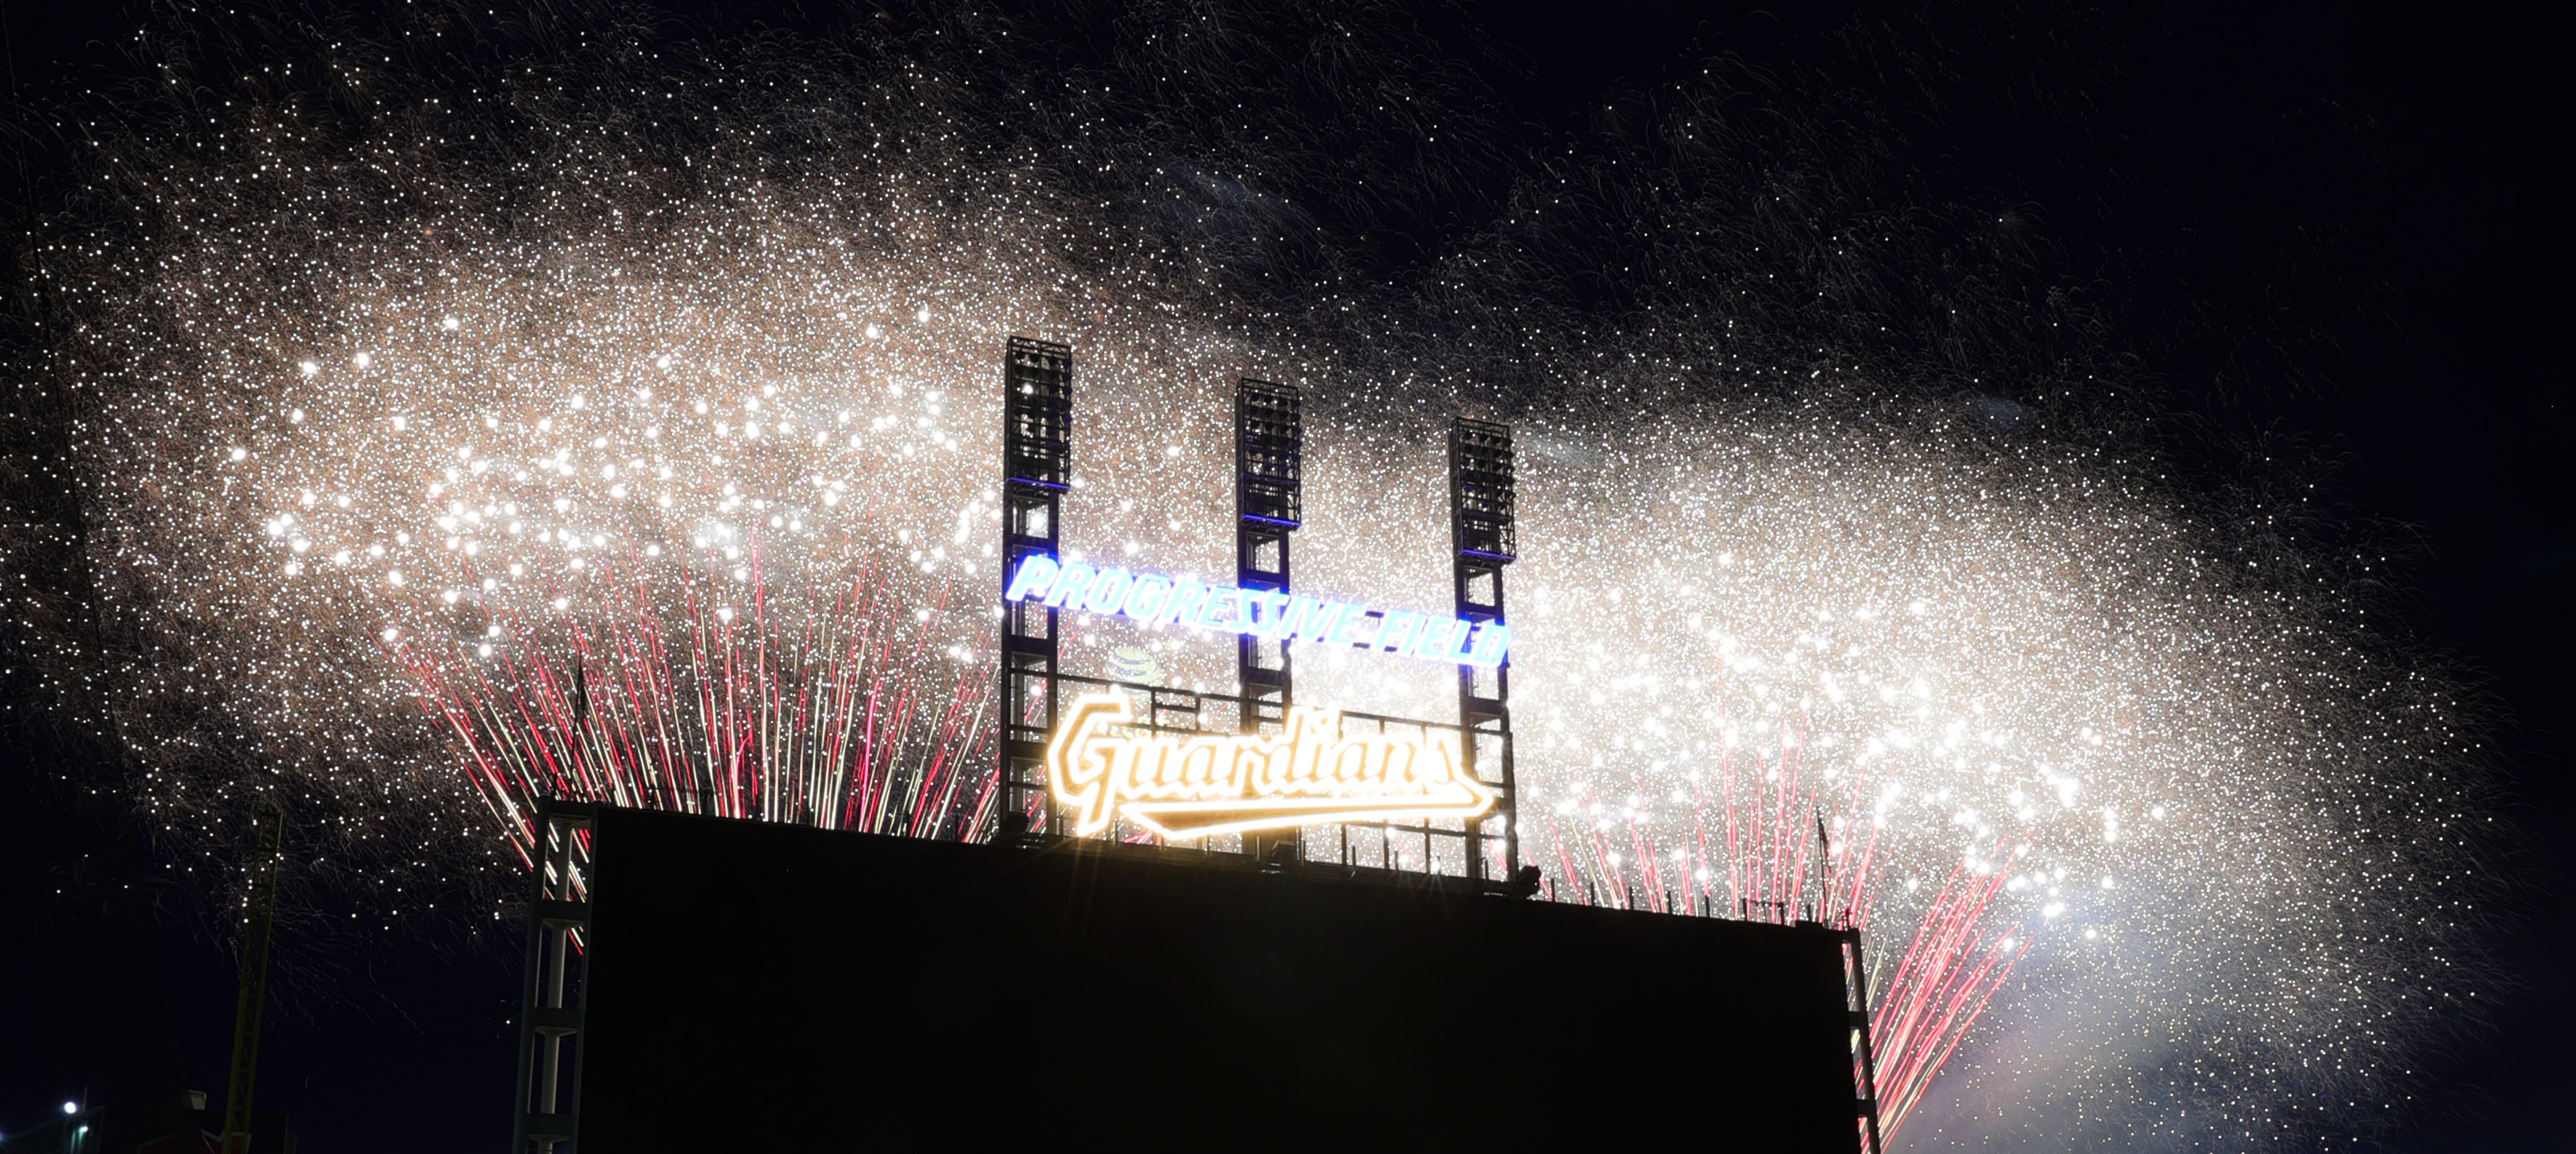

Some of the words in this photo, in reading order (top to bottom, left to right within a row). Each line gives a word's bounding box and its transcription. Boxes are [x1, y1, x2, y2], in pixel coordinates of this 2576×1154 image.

[1005, 553, 1367, 645] PROGRESSIVE
[1372, 607, 1512, 667] FIELD
[1049, 693, 1493, 839] Guardians
